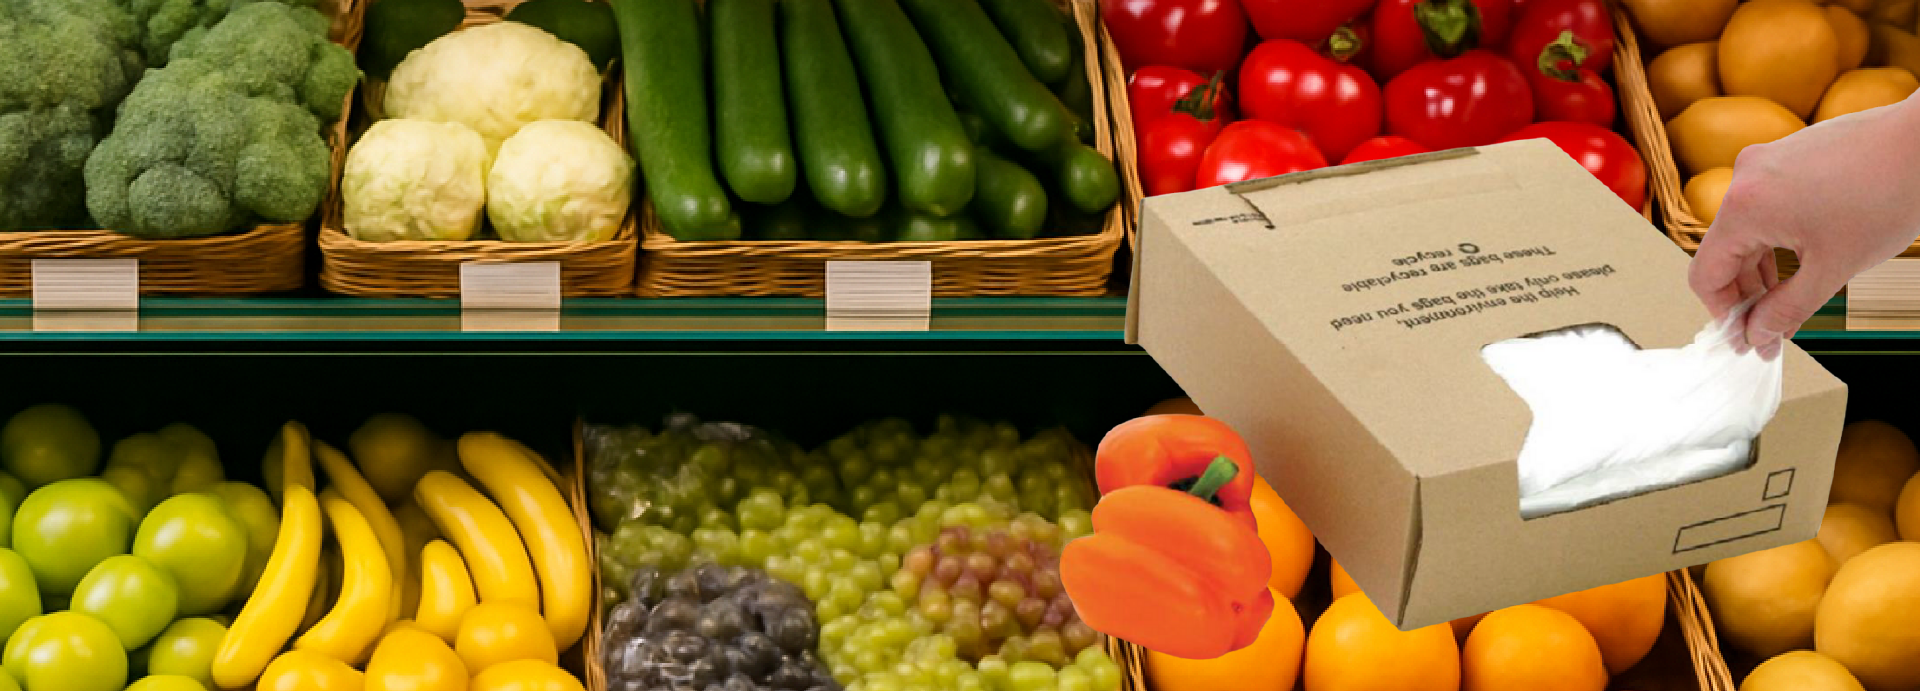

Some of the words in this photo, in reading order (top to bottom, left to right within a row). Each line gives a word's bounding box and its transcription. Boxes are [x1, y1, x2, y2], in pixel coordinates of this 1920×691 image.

[1391, 249, 1453, 266] recycle
[1459, 253, 1503, 267] bags
[1503, 245, 1556, 260] These
[1429, 261, 1457, 272] are
[1561, 264, 1616, 281] please
[1341, 268, 1428, 292] recyclable
[1486, 281, 1524, 294] take
[1524, 274, 1560, 288] only
[1456, 287, 1486, 300] the
[1509, 291, 1539, 304] the
[1538, 285, 1580, 299] Help
[1411, 295, 1457, 310] bags
[1376, 302, 1410, 319] you
[1396, 297, 1507, 329] environment,
[1330, 311, 1373, 331] need
